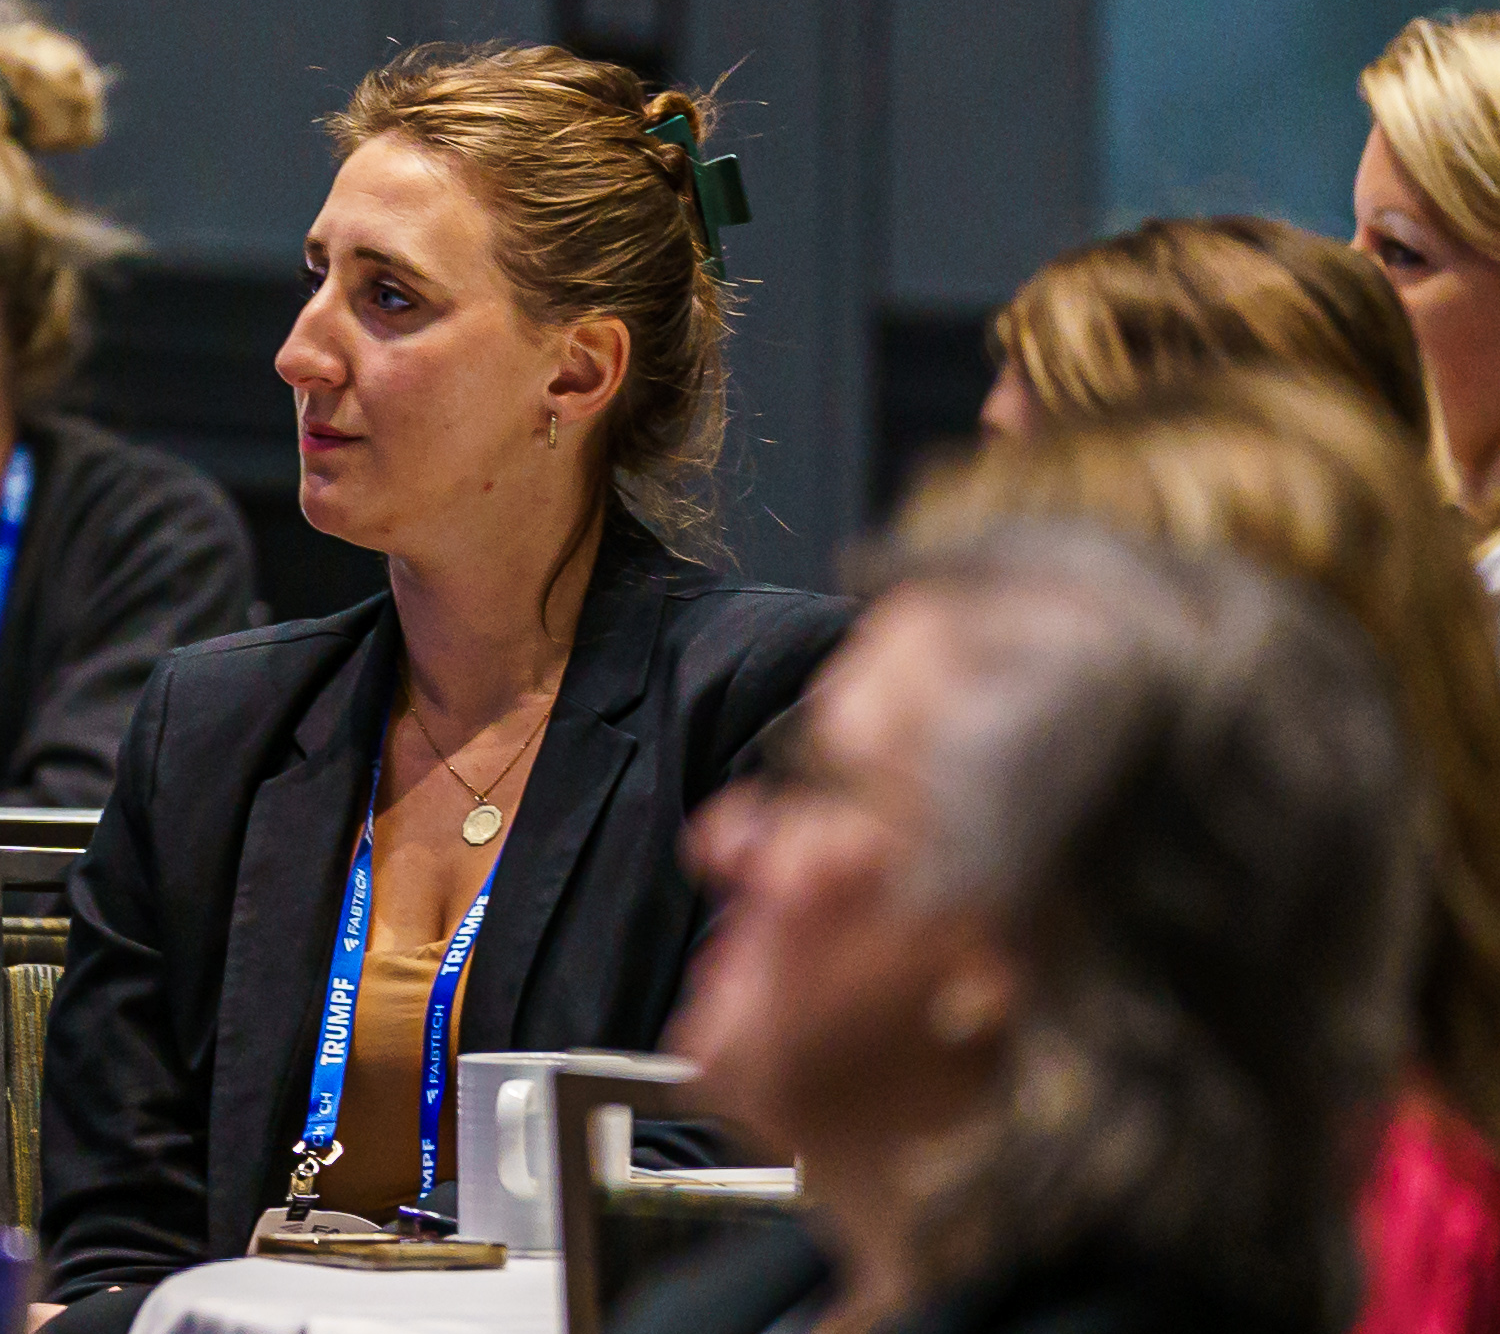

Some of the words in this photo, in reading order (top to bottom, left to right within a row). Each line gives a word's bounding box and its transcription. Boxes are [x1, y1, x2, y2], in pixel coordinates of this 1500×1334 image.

[346, 868, 367, 936] FABTECH
[320, 977, 355, 1066] TRUMPF
[429, 1004, 446, 1084] FABTECH
